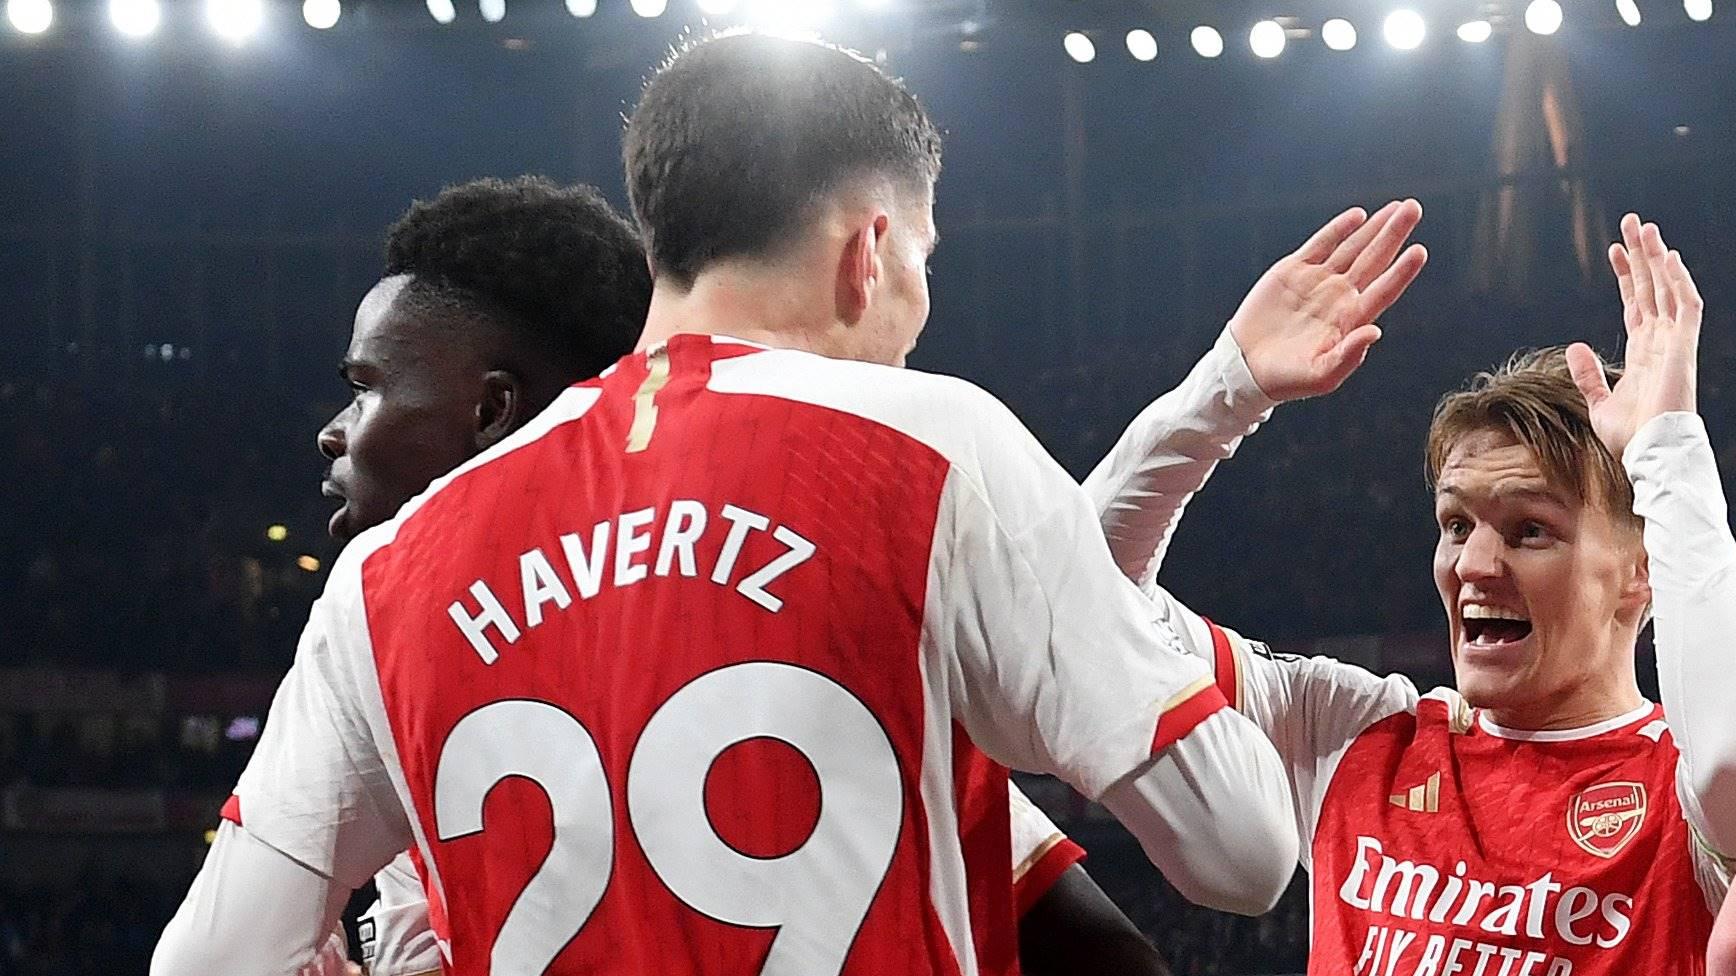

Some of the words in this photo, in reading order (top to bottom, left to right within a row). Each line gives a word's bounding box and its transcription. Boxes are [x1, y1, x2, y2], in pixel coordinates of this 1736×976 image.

[448, 499, 817, 665] HAVERTZ
[1580, 793, 1635, 813] Arsenal
[1339, 835, 1634, 950] Emirates
